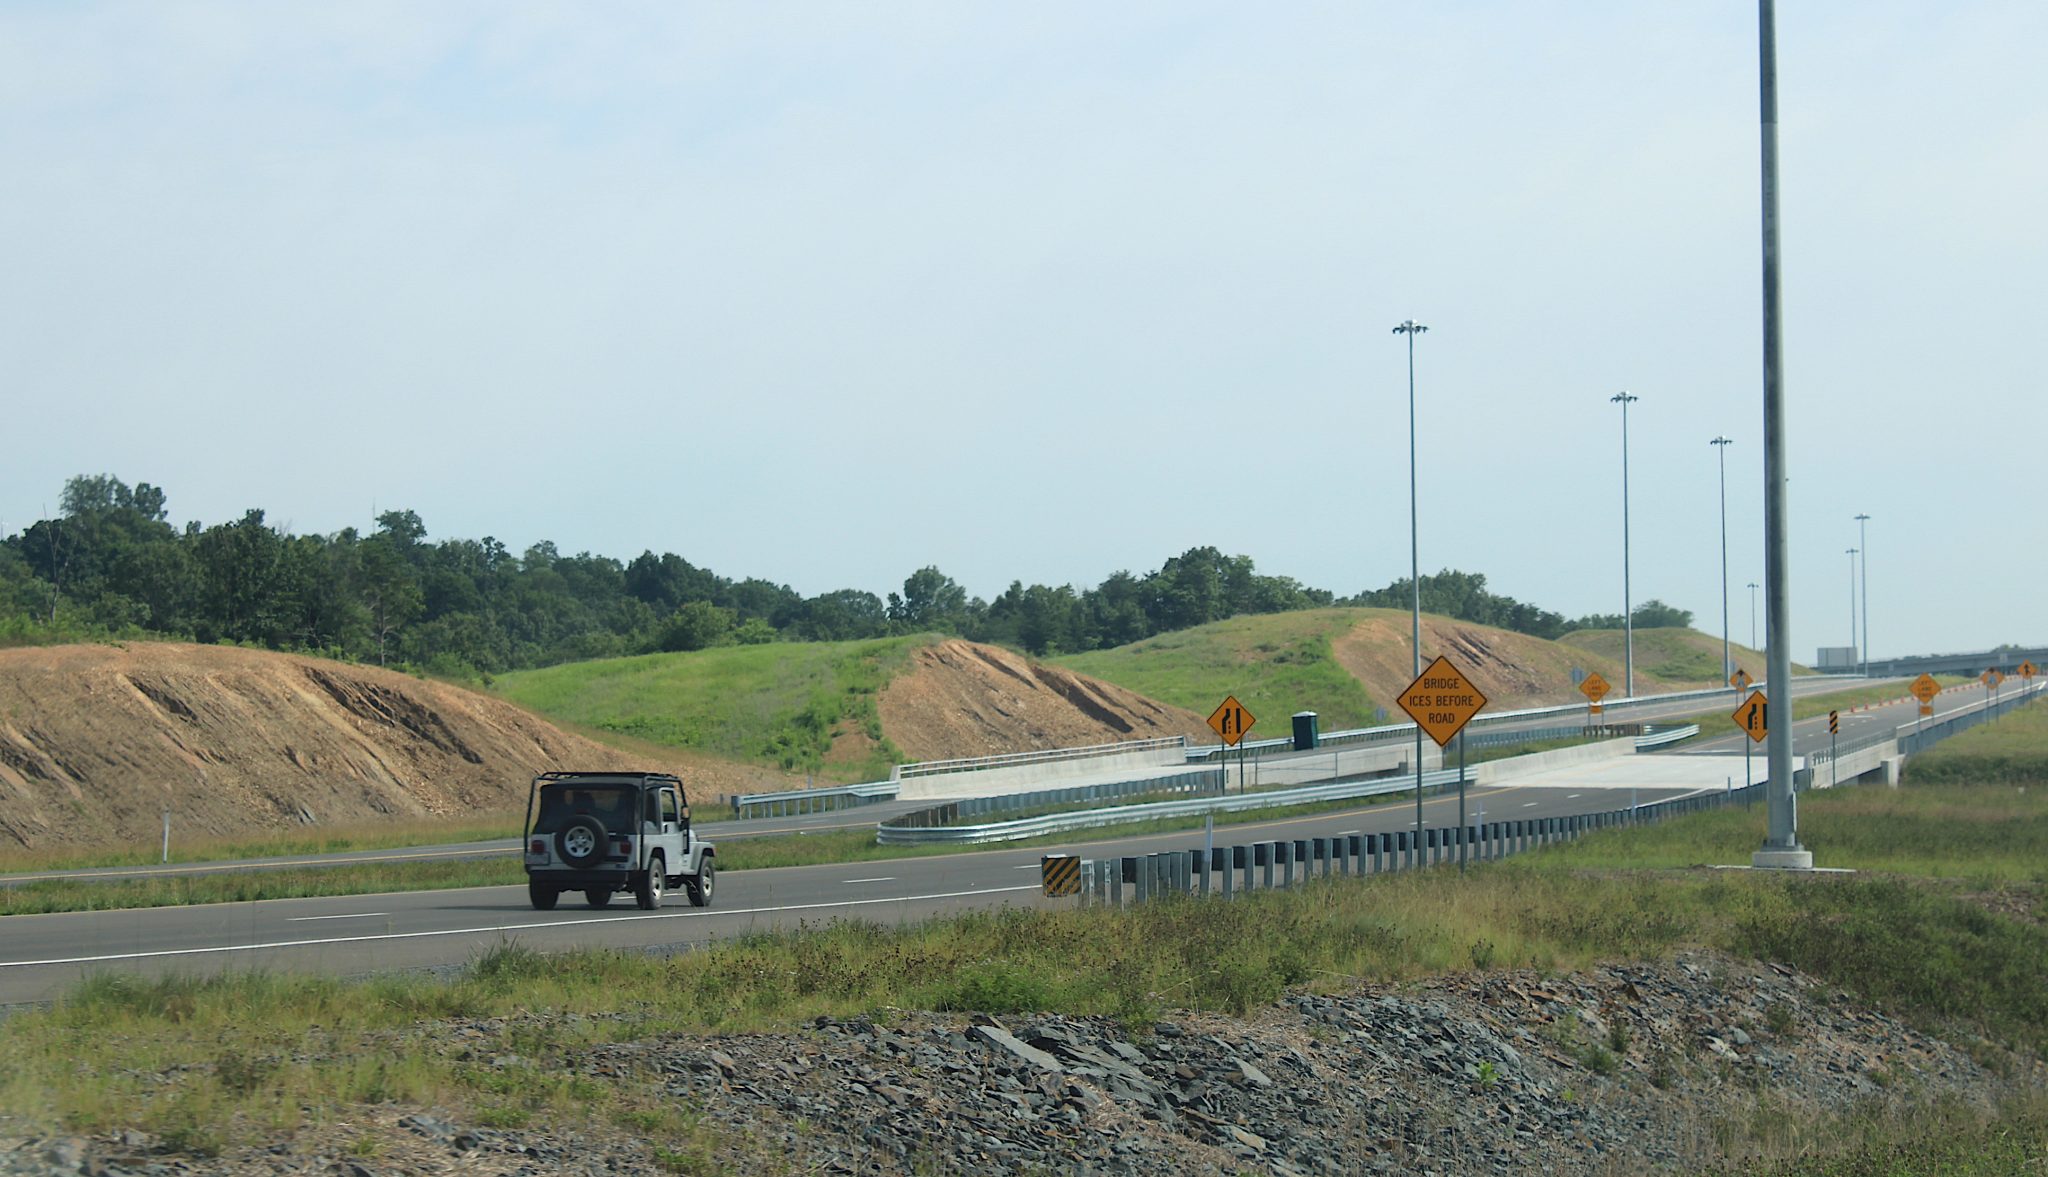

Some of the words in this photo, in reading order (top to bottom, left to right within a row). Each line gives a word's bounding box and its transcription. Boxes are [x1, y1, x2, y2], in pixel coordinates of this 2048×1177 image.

[1423, 678, 1460, 689] BRIDGE
[1409, 695, 1432, 706] ICES
[1436, 695, 1474, 706] BEFORE
[1428, 712, 1455, 724] ROAD
